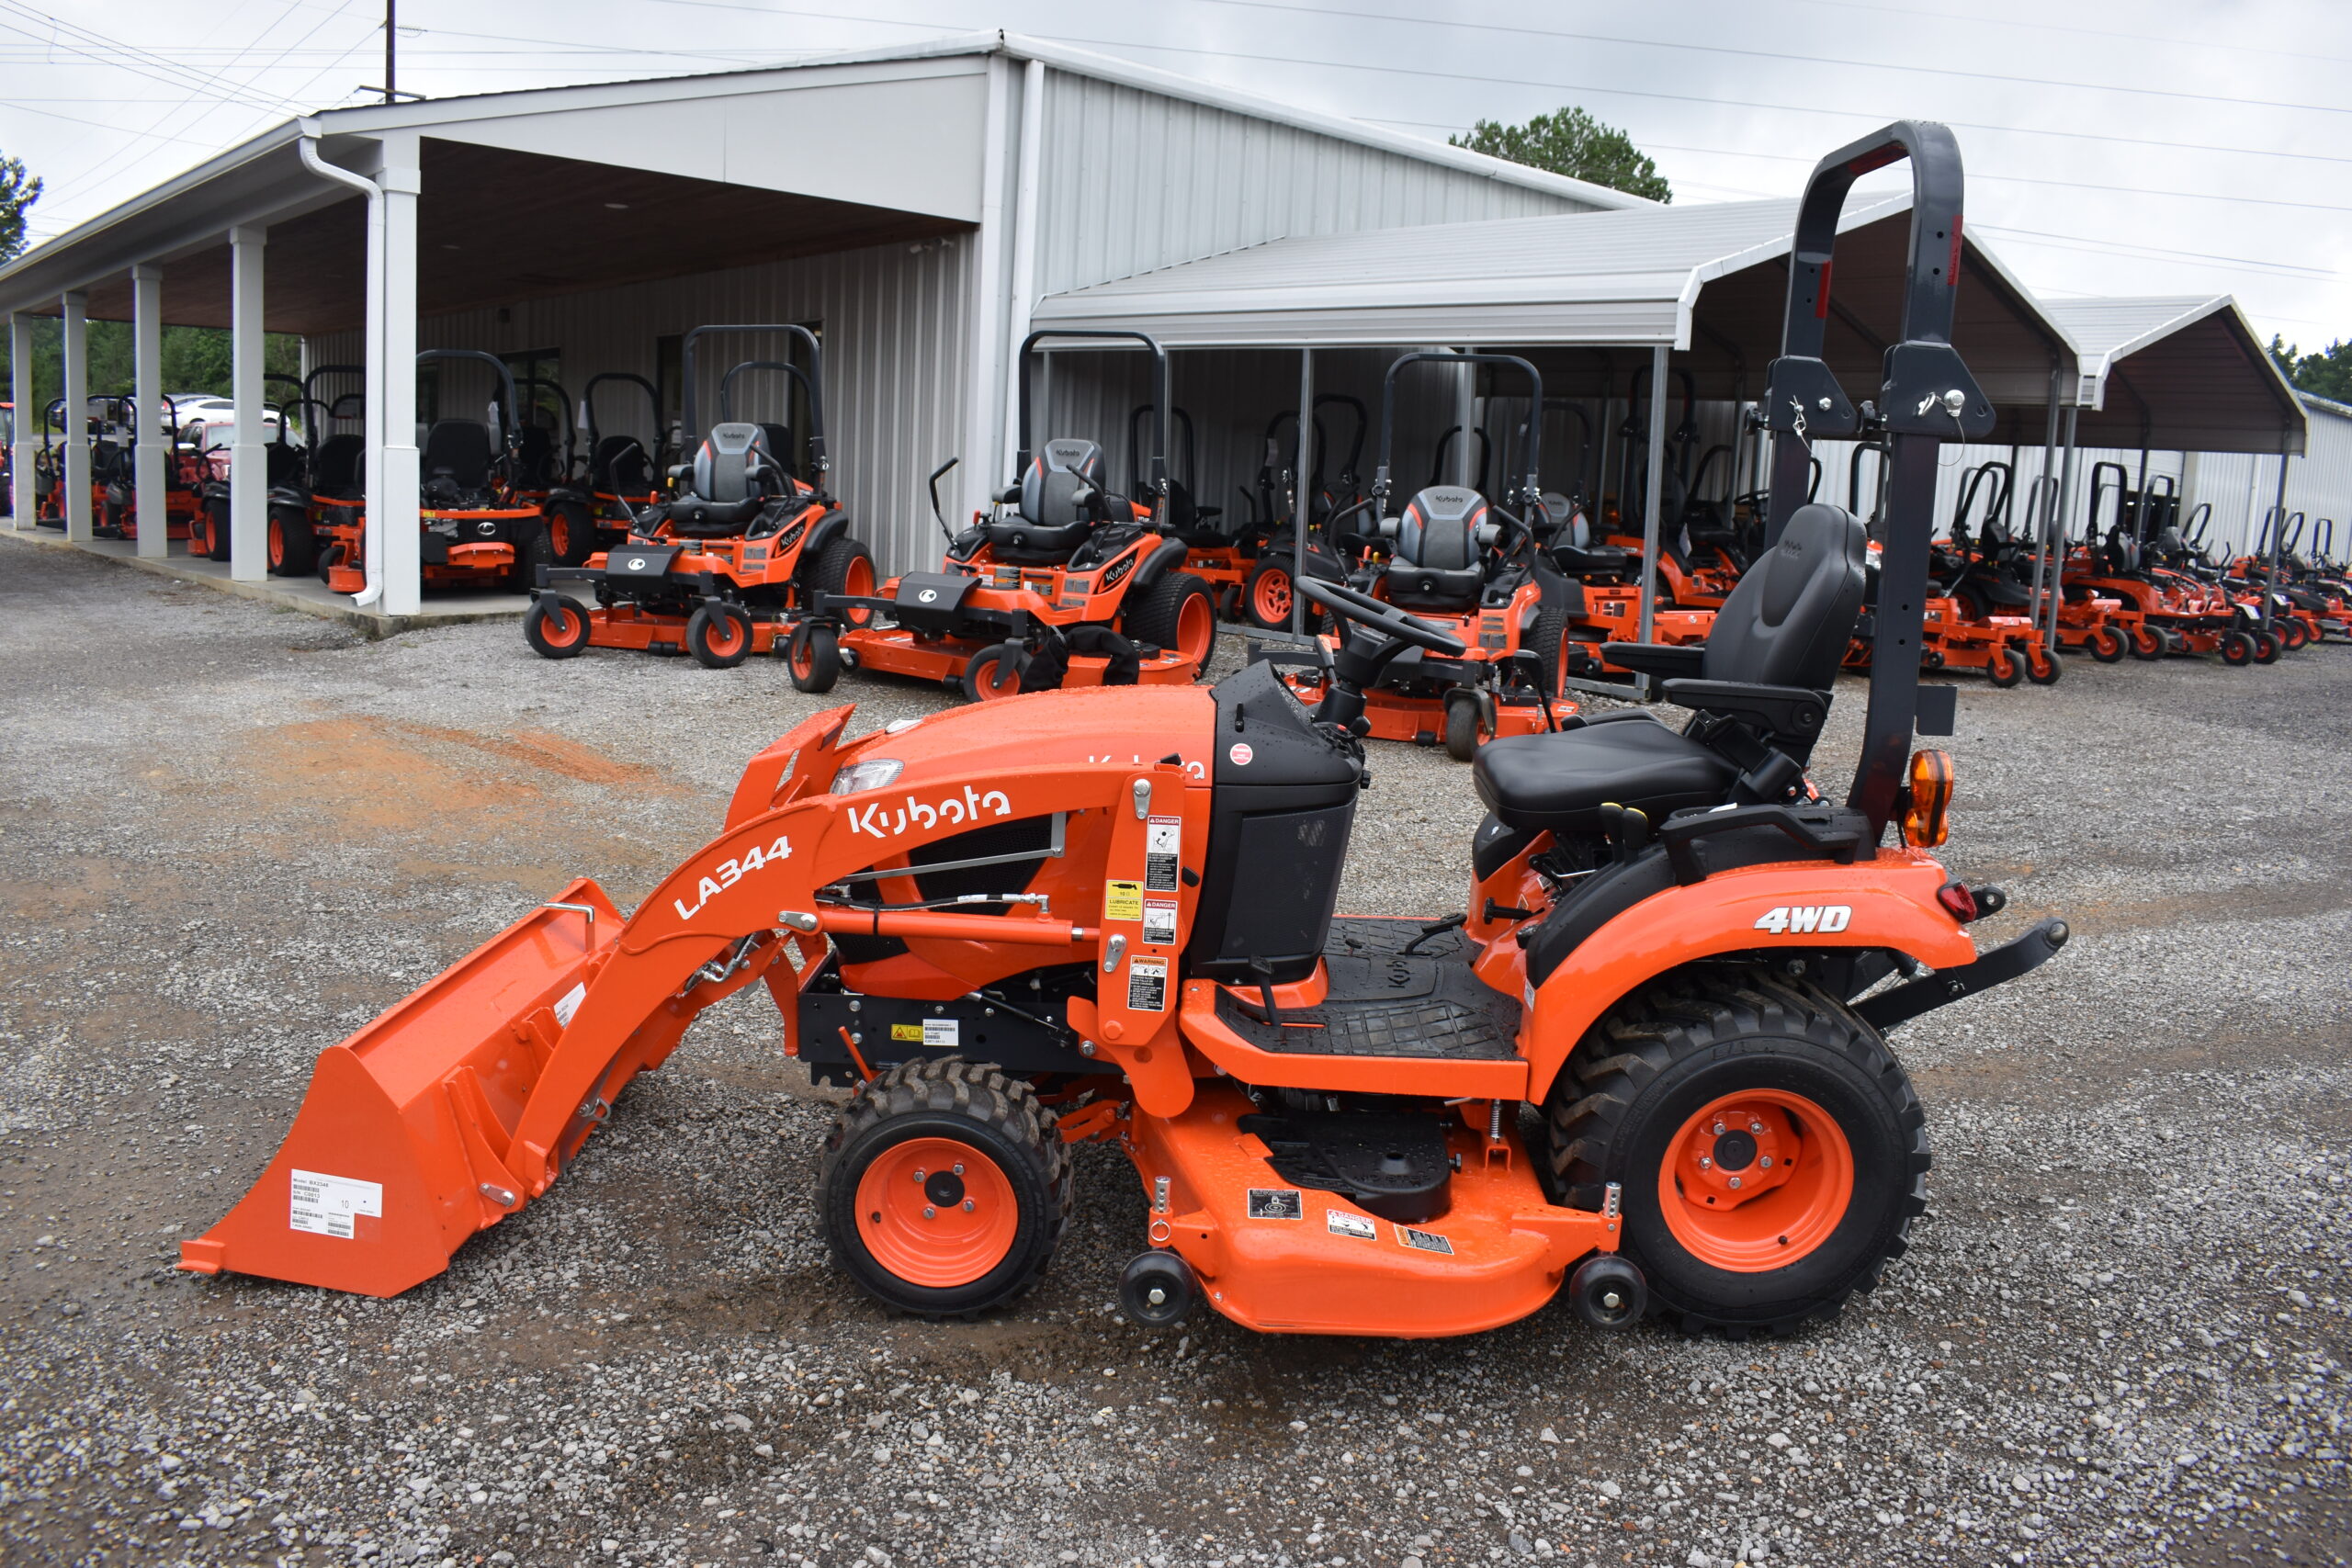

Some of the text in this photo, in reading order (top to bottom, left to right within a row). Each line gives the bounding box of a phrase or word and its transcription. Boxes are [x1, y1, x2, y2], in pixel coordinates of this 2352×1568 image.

[1057, 447, 1080, 457] Kubota
[1435, 494, 1464, 502] Kubota
[780, 525, 805, 547] Kubota
[1105, 557, 1135, 581] Kubota
[847, 784, 1012, 838] Kubota
[673, 835, 793, 920] LA344
[1753, 905, 1852, 934] 4WD
[341, 1199, 350, 1209] 10
[1338, 1212, 1374, 1225] DANGER
